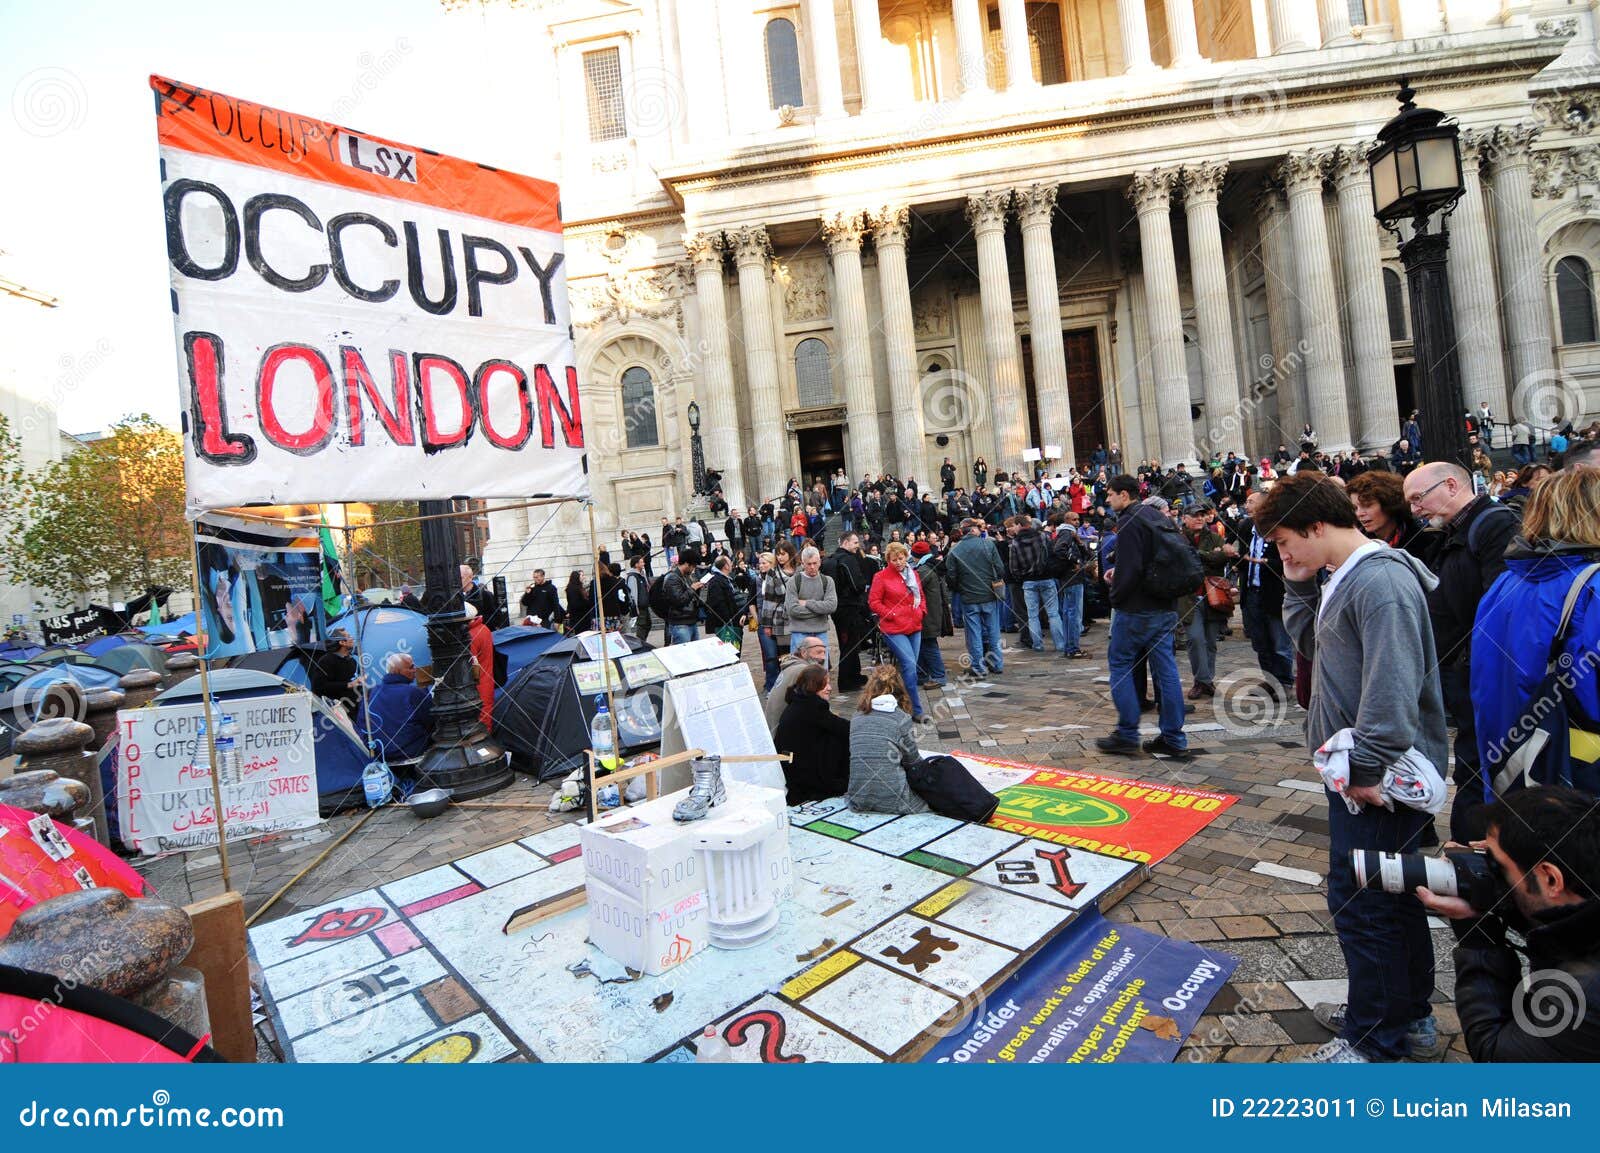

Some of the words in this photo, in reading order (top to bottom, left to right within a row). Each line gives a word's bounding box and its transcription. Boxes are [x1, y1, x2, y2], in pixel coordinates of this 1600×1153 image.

[164, 178, 564, 324] OCCUPY
[183, 331, 585, 467] LONDON
[245, 729, 303, 750] POVERTY
[268, 775, 310, 797] STATES
[1034, 771, 1053, 783] &
[1054, 775, 1222, 812] ORGANISE
[998, 1025, 1036, 1062] great
[1029, 997, 1064, 1026] work
[1054, 985, 1073, 997] is
[1066, 959, 1097, 984] theft
[1091, 948, 1107, 961] of
[1101, 979, 1146, 1026] principle
[1162, 957, 1221, 1012] Occupy
[936, 998, 1021, 1063] onsider
[1068, 1004, 1088, 1017] is
